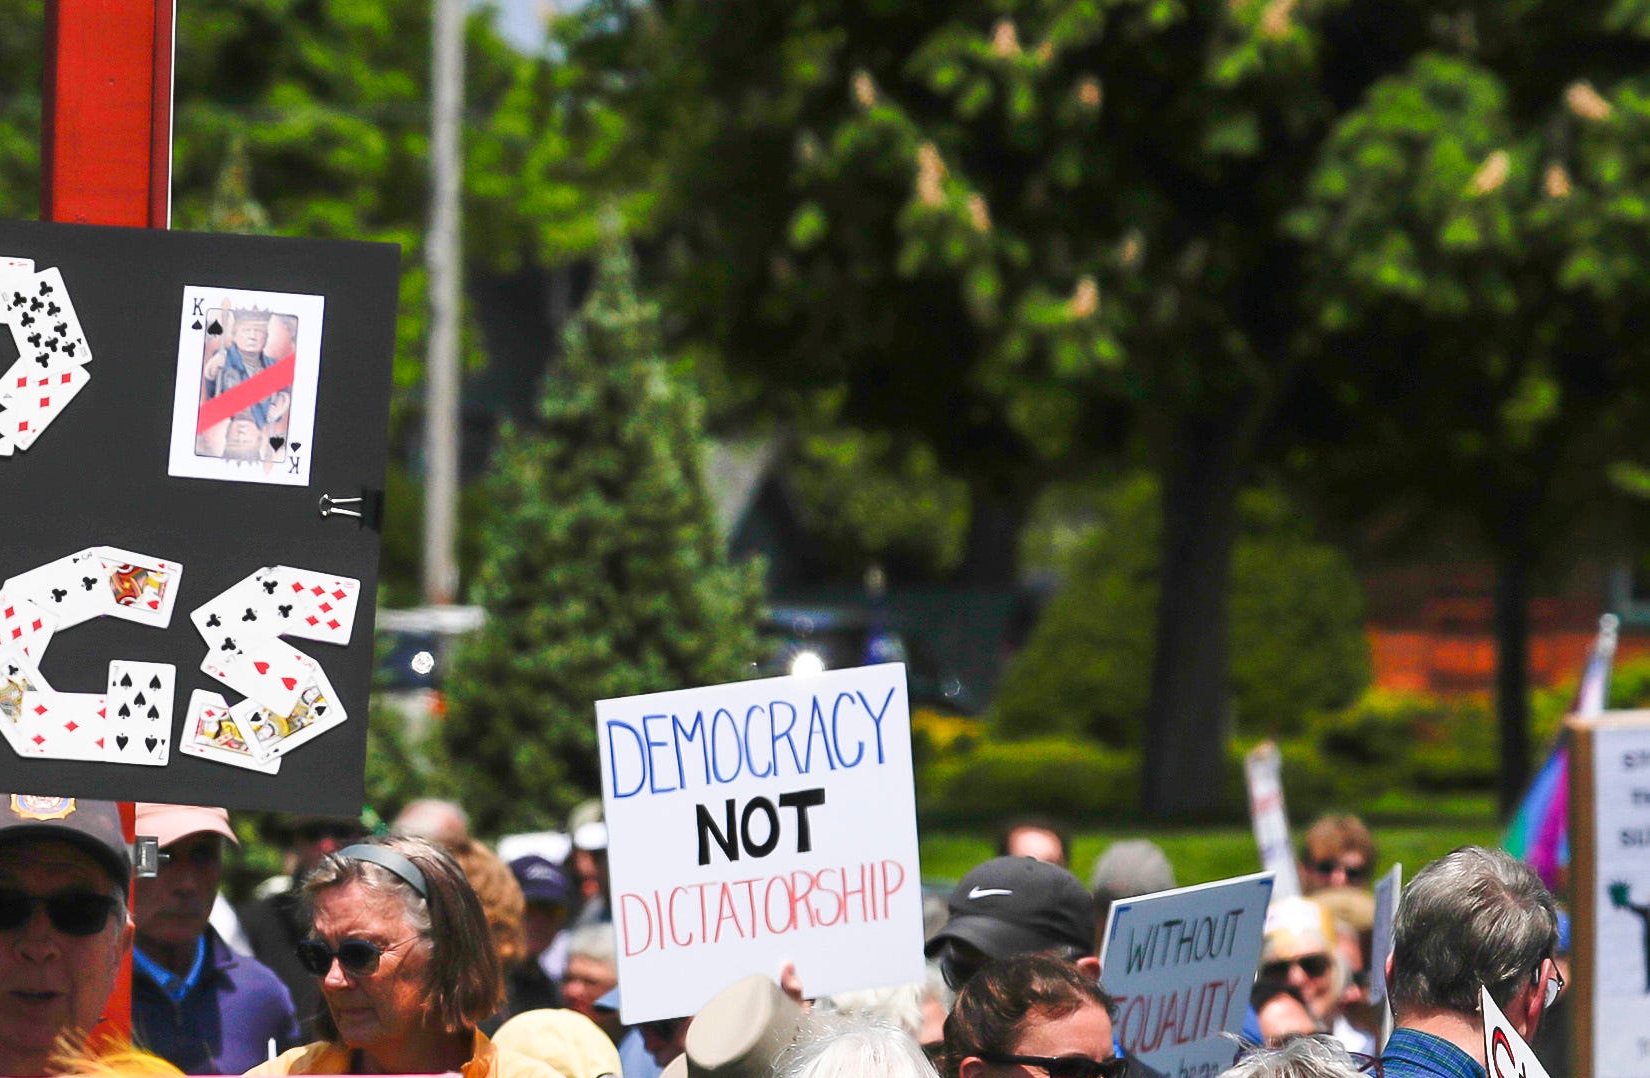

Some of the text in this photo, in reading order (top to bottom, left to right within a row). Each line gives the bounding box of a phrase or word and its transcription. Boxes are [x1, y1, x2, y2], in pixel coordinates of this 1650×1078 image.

[606, 686, 896, 799] DEMOCRACY
[696, 788, 826, 866] NOT
[621, 859, 906, 957] DICTATORSHIP
[1126, 908, 1245, 975] WITHOUT
